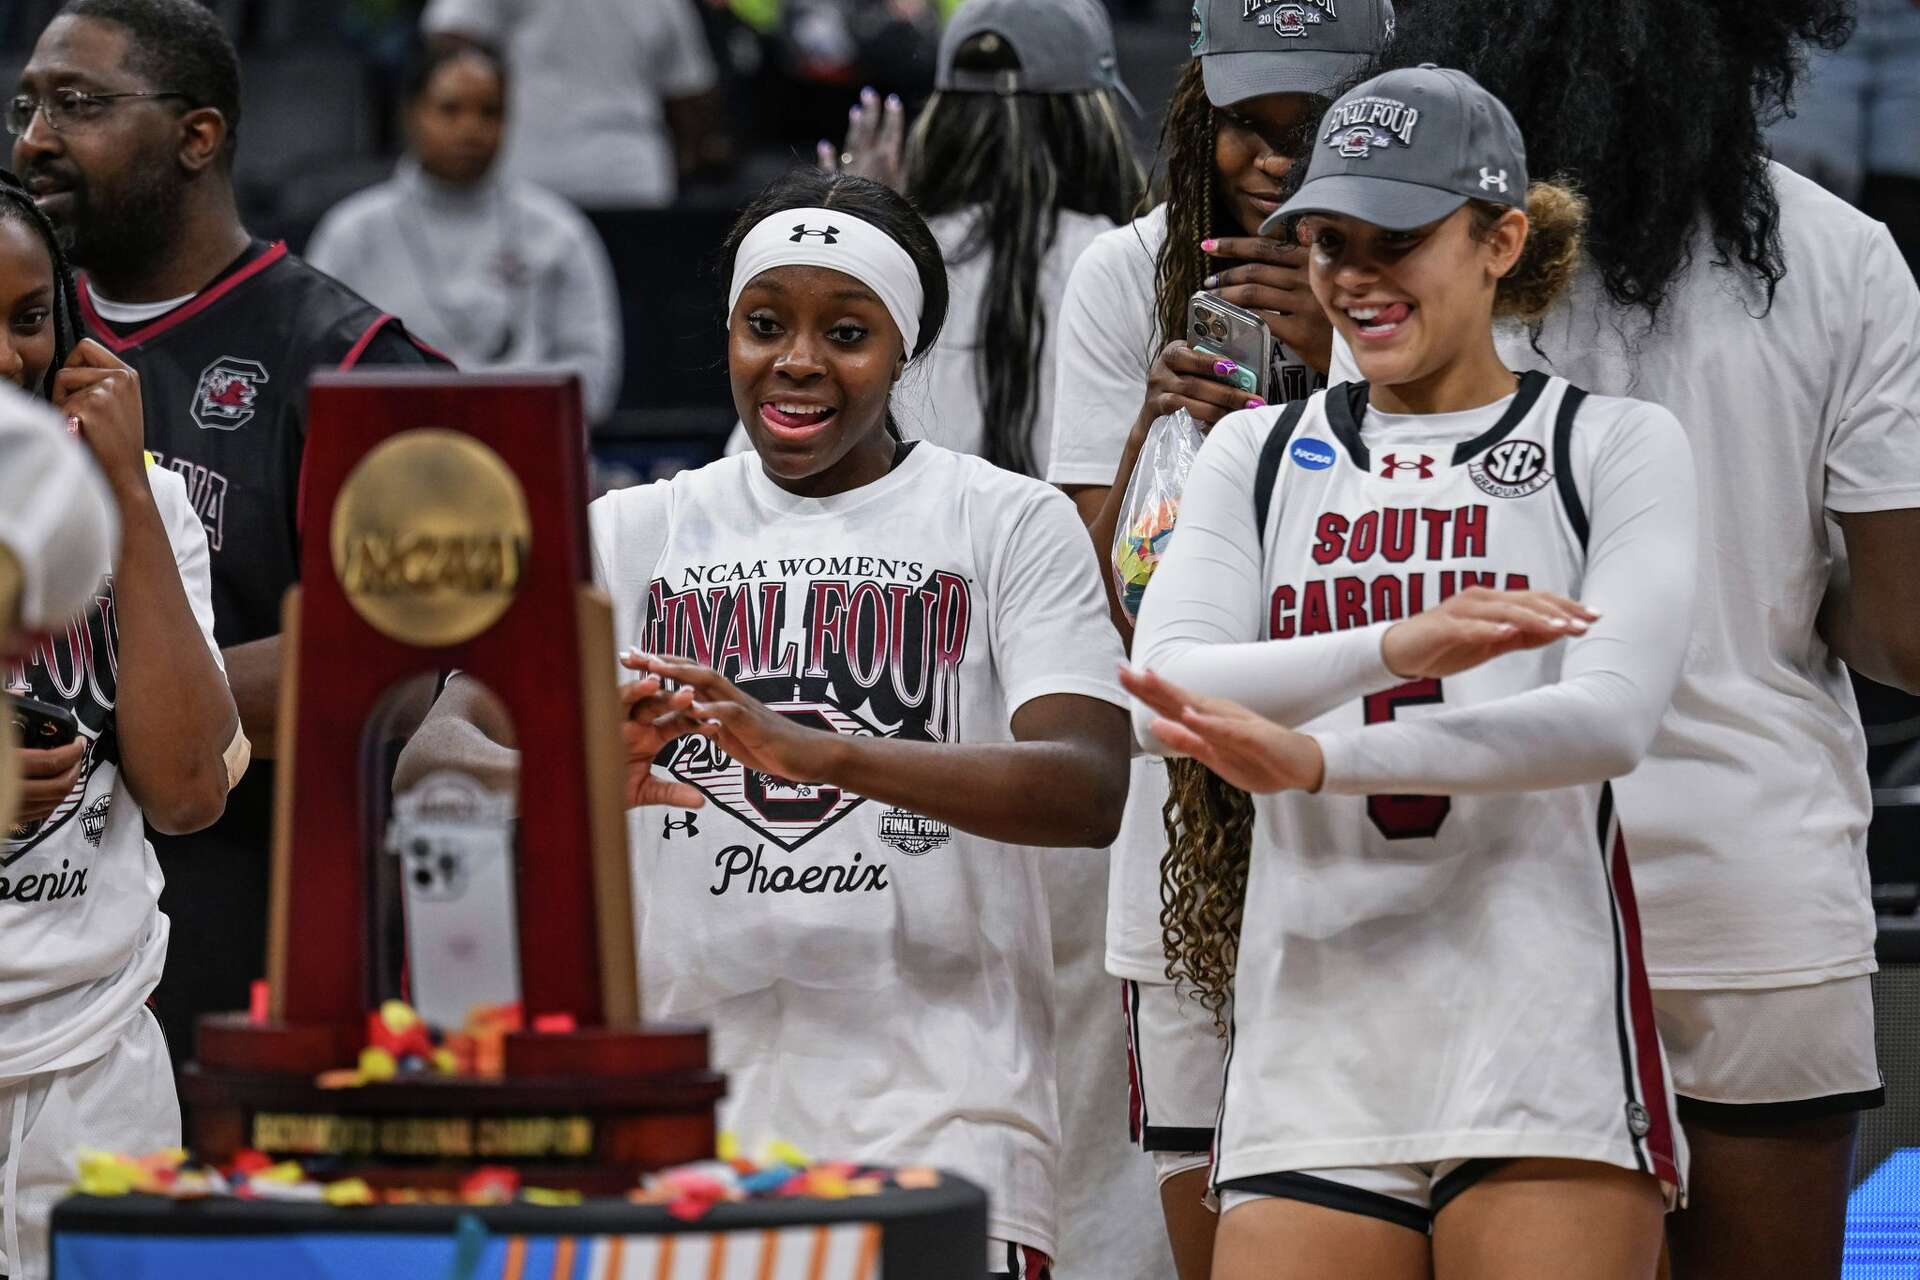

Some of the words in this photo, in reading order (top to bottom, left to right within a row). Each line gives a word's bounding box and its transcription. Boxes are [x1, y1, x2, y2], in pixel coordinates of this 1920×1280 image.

[1257, 14, 1272, 26] 20
[1306, 12, 1320, 24] 26
[1368, 103, 1419, 145] FOUR
[1487, 442, 1542, 483] SEC
[1474, 474, 1538, 497] GRADUATE
[1312, 504, 1489, 566] SOUTH
[682, 560, 768, 588] NCAA
[778, 556, 923, 583] WOMEN'S
[640, 577, 800, 693] FINAL
[804, 569, 972, 744] FOUR
[883, 817, 915, 834] FINAL
[918, 819, 949, 836] FOUR
[710, 843, 889, 896] Phoenix
